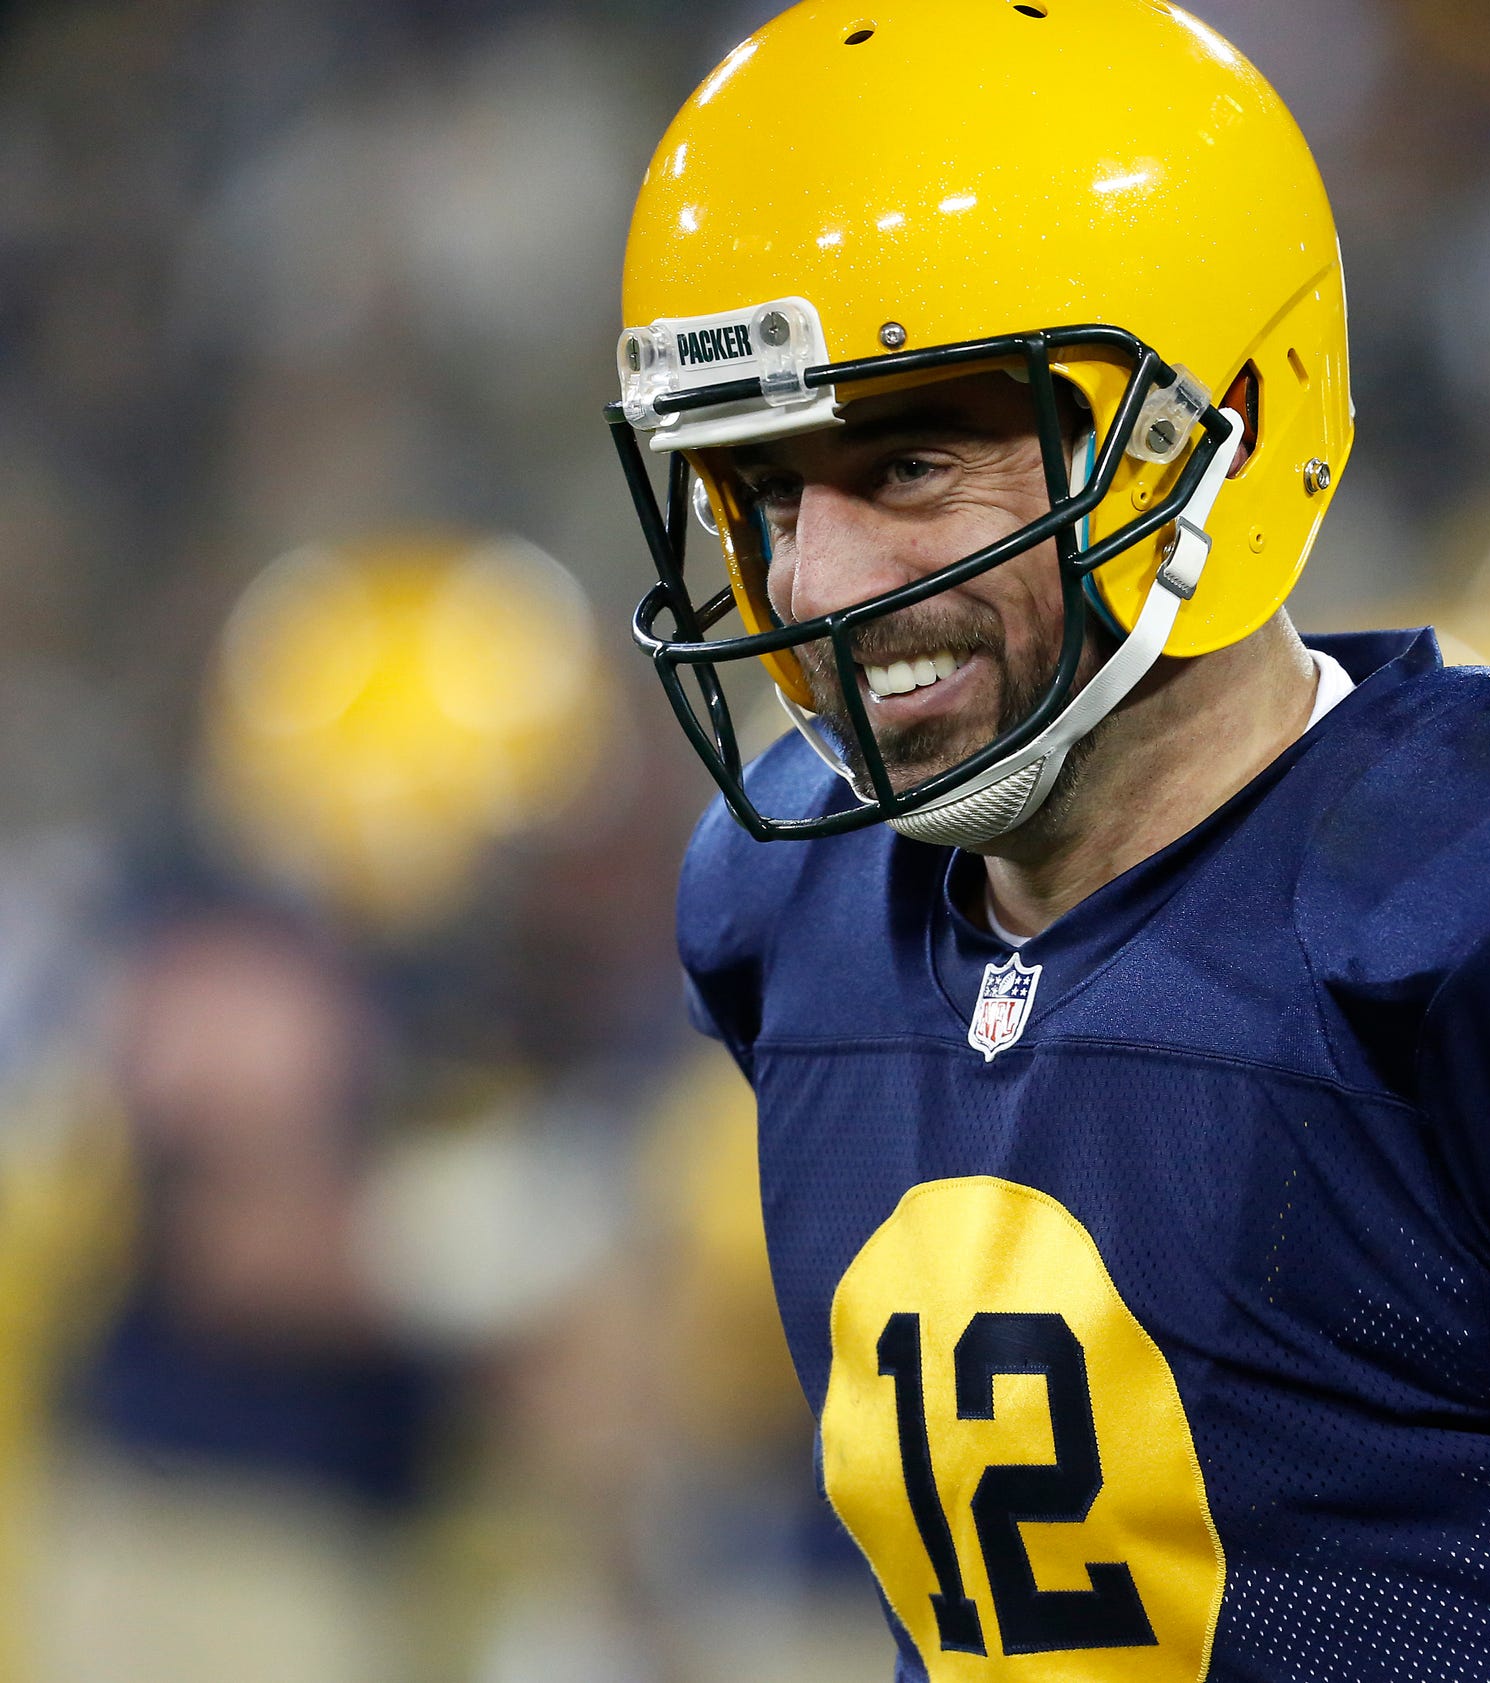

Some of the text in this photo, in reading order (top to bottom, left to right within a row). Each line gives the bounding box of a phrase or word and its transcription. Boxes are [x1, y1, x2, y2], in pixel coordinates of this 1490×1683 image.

[676, 324, 752, 366] PACKER
[976, 1001, 1016, 1043] NFL
[877, 1312, 1160, 1657] 12
